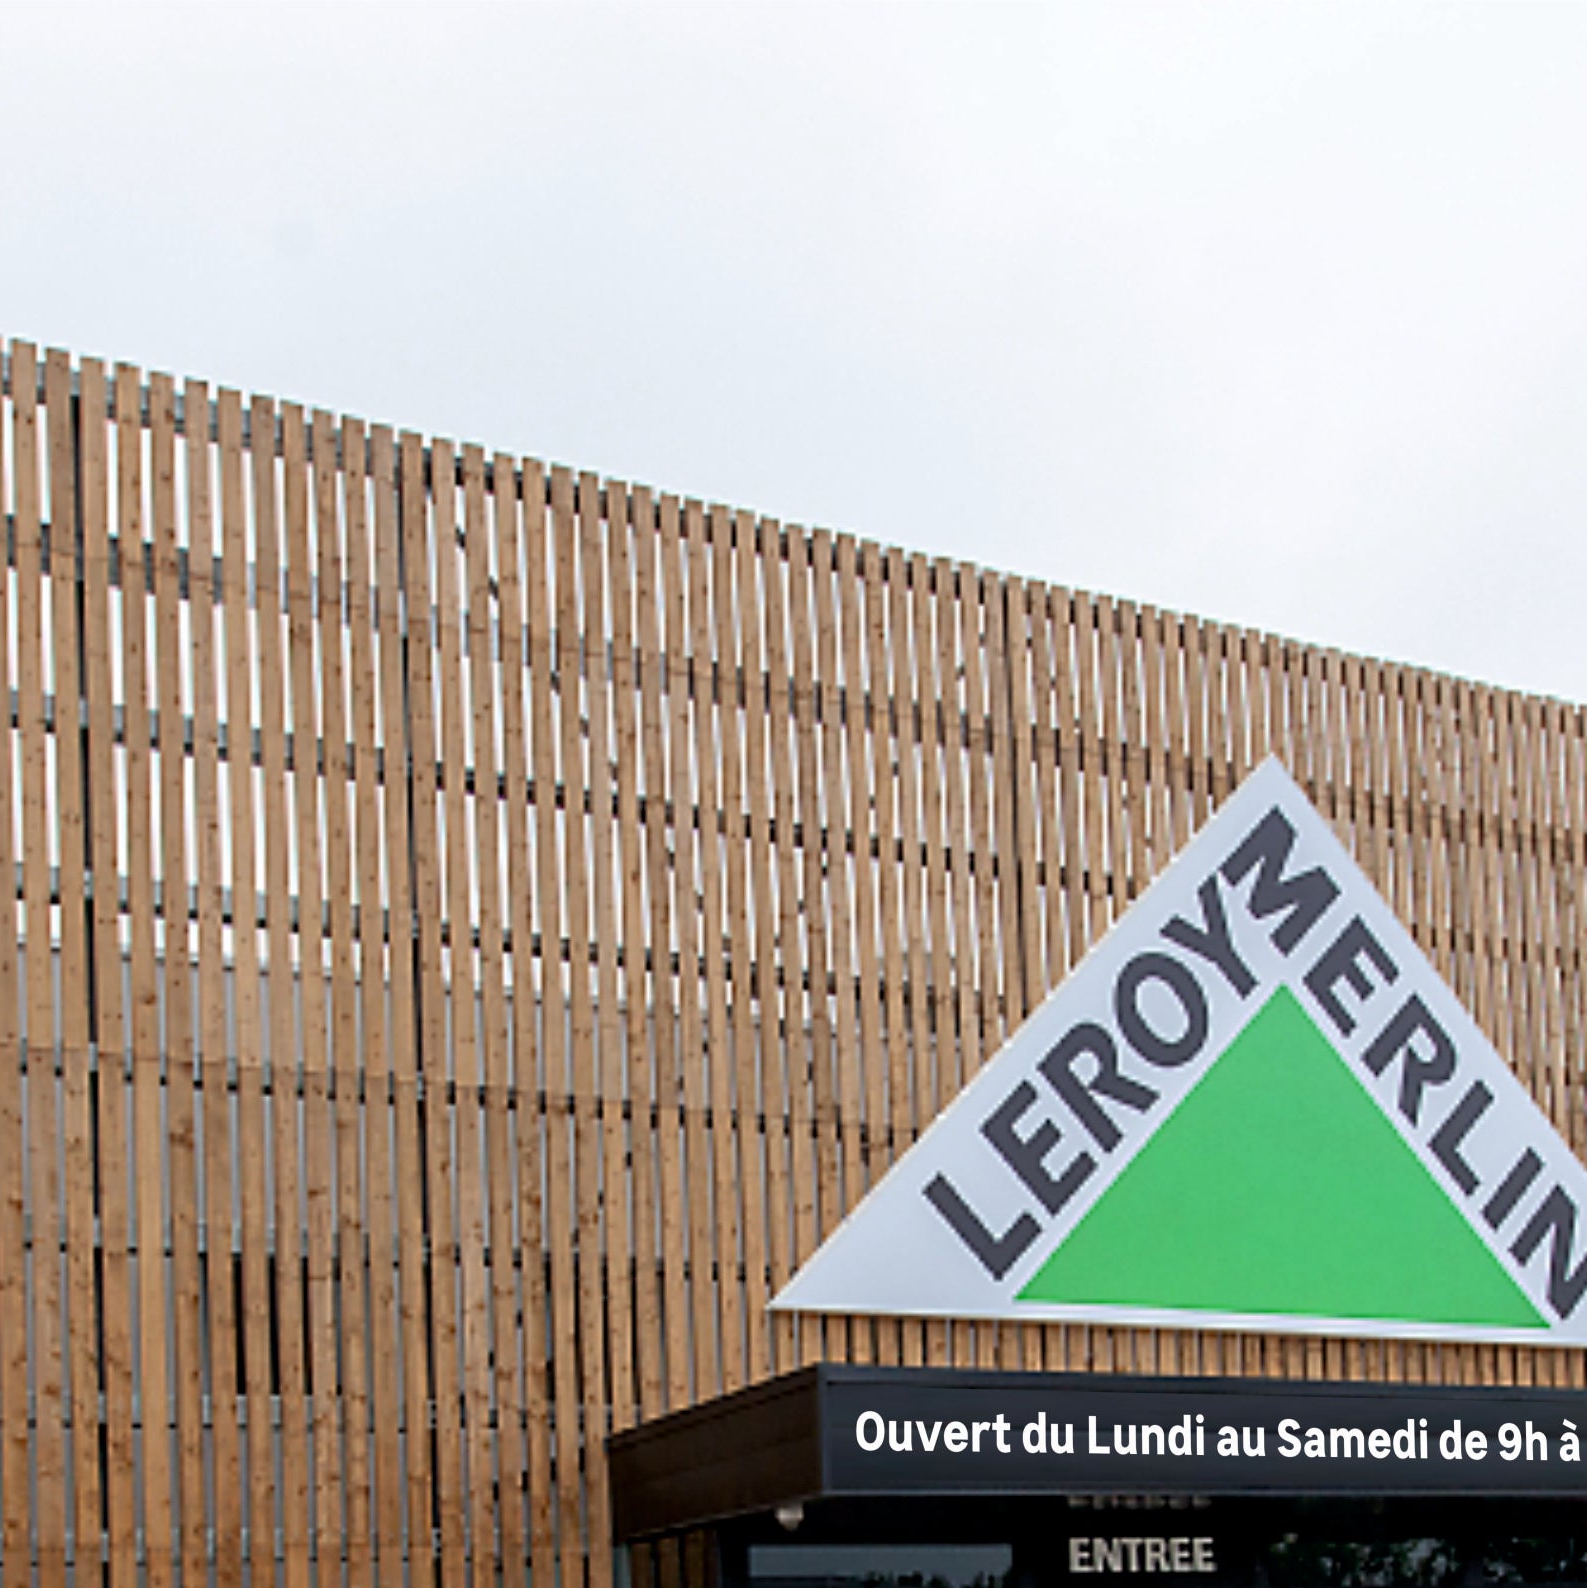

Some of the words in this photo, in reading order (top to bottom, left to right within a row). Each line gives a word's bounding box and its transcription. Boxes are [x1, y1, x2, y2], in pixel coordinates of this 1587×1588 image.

[921, 869, 1259, 1282] LEROY
[855, 1410, 1011, 1454] Ouvert
[1022, 1411, 1075, 1455] du
[1088, 1413, 1205, 1456] Lundi
[1216, 1425, 1266, 1457] au
[1277, 1418, 1428, 1460] Samedi
[1439, 1419, 1488, 1461] de
[1497, 1420, 1548, 1461] 9h
[1559, 1418, 1581, 1462] à
[1068, 1536, 1217, 1573] ENTREE
